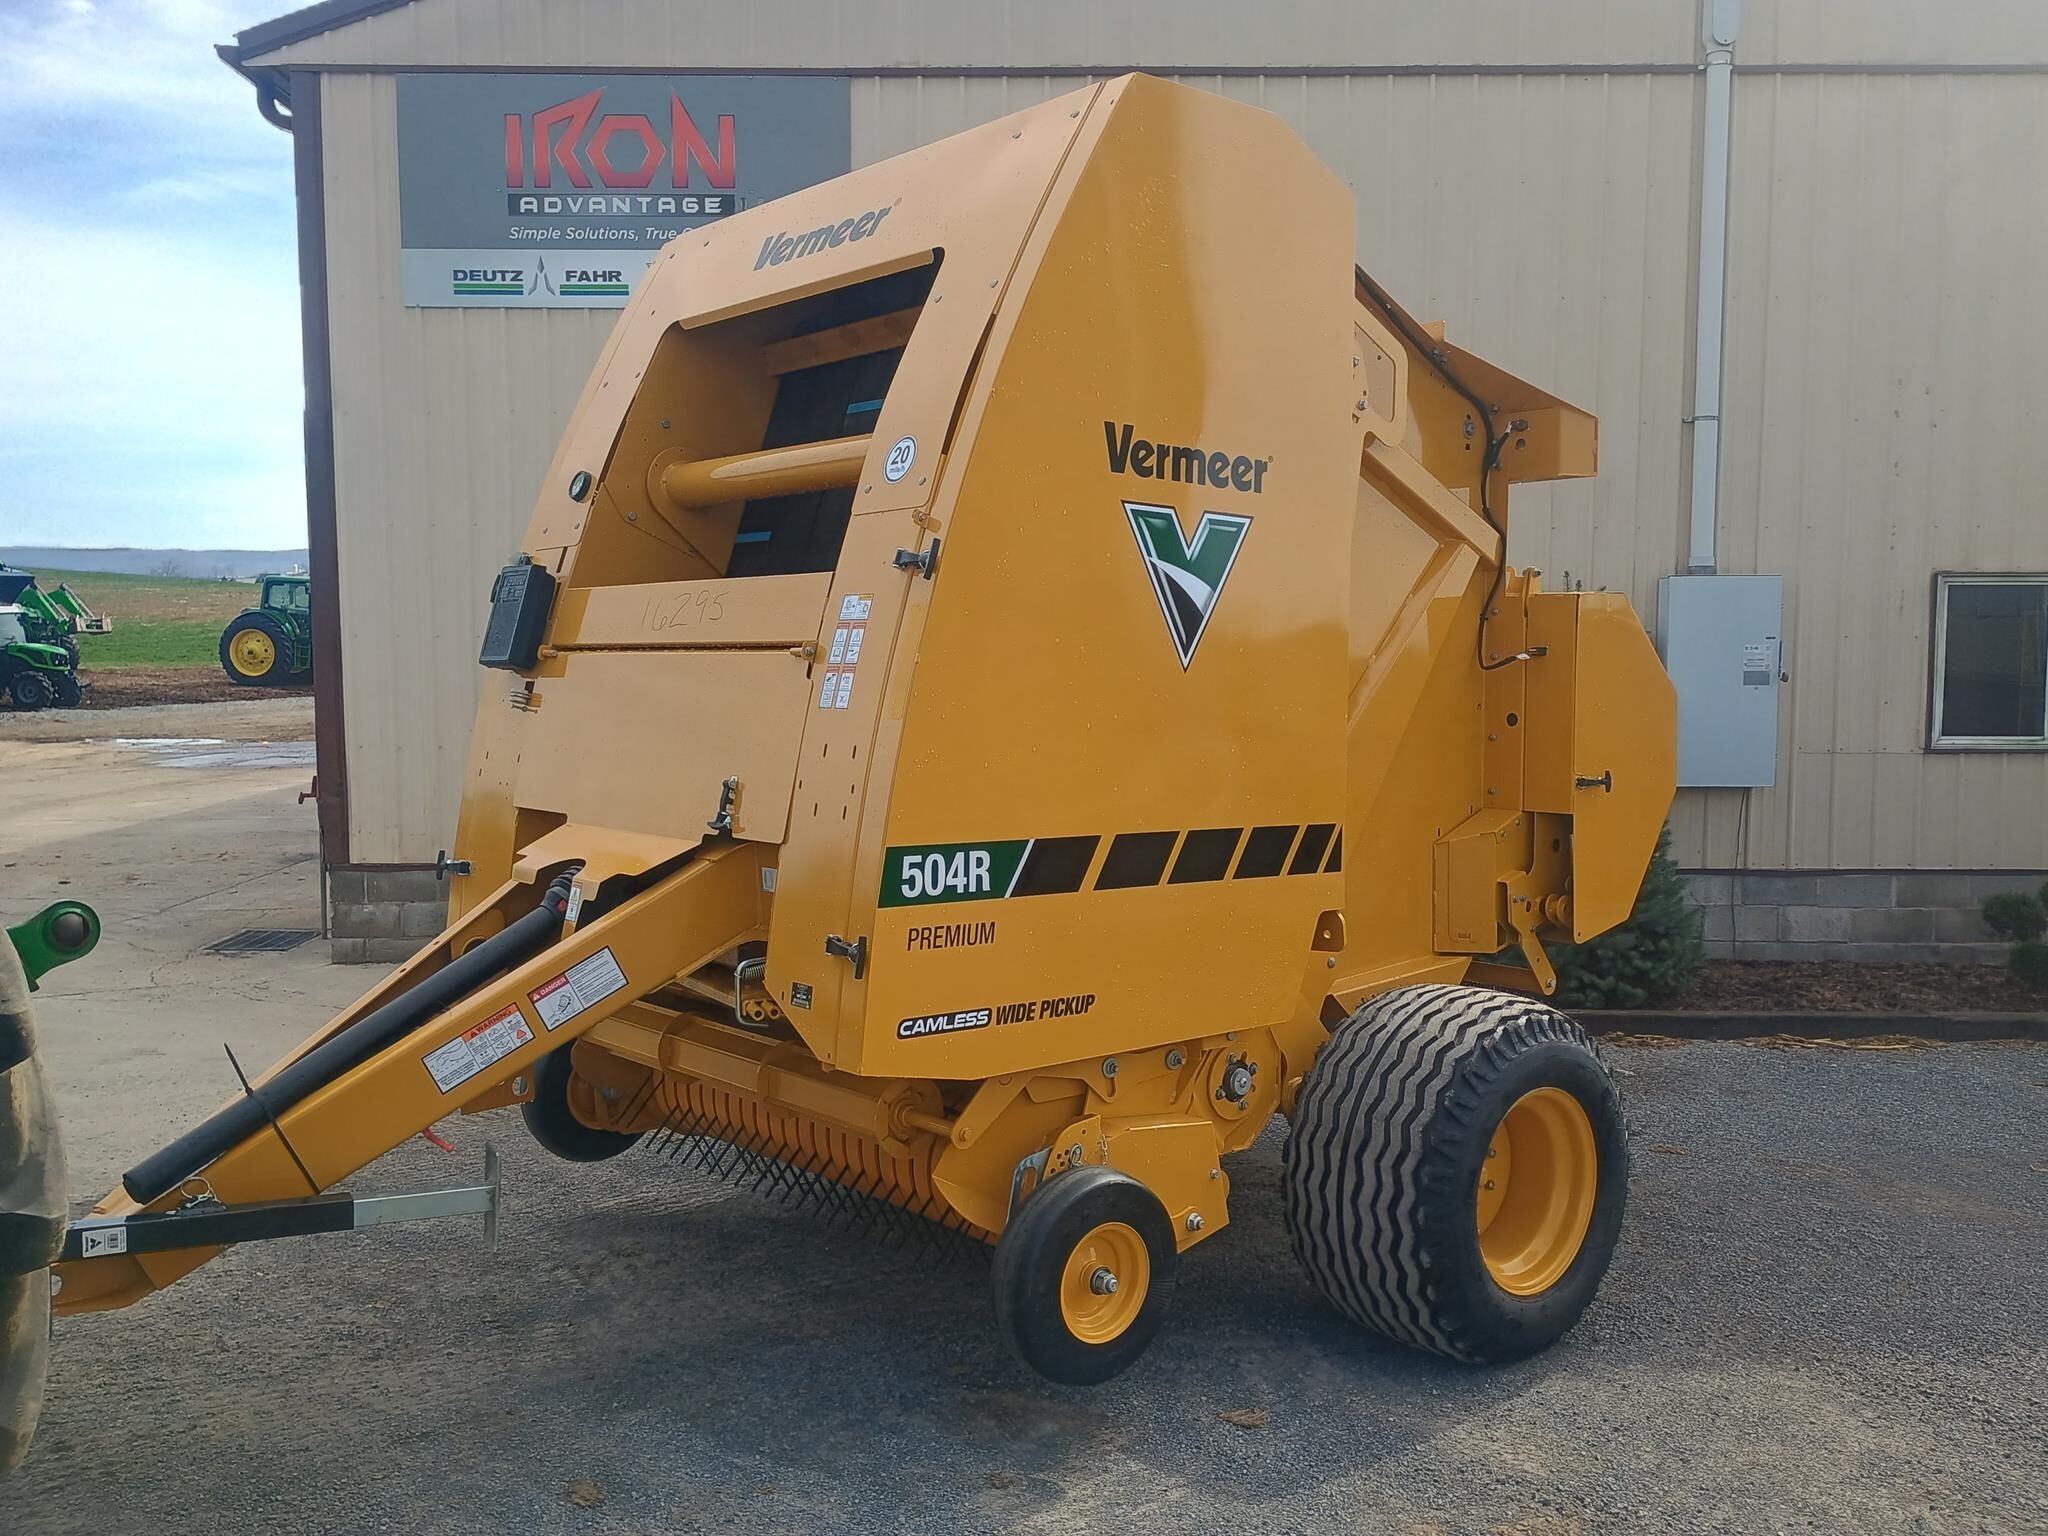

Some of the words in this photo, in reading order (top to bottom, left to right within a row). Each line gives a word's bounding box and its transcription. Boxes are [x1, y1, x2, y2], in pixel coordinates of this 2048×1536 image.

[504, 87, 736, 189] IRON
[519, 196, 723, 214] ADVANTAGE
[508, 226, 561, 242] Simple
[565, 226, 639, 242] Solutions,
[645, 227, 677, 241] True
[753, 206, 892, 271] Vermeer
[453, 269, 524, 282] DEUTZ
[565, 270, 622, 282] FAHR
[890, 445, 910, 465] 20
[1104, 420, 1268, 494] Vermeer
[641, 590, 729, 632] 16295
[901, 850, 991, 898] 504R
[907, 921, 996, 952] PREMIUM
[540, 977, 567, 995] DANGER
[475, 1009, 512, 1033] WARNING
[899, 1009, 990, 1036] CAMLESS
[996, 1002, 1037, 1026] WIDE
[1039, 994, 1095, 1020] PICKUP
